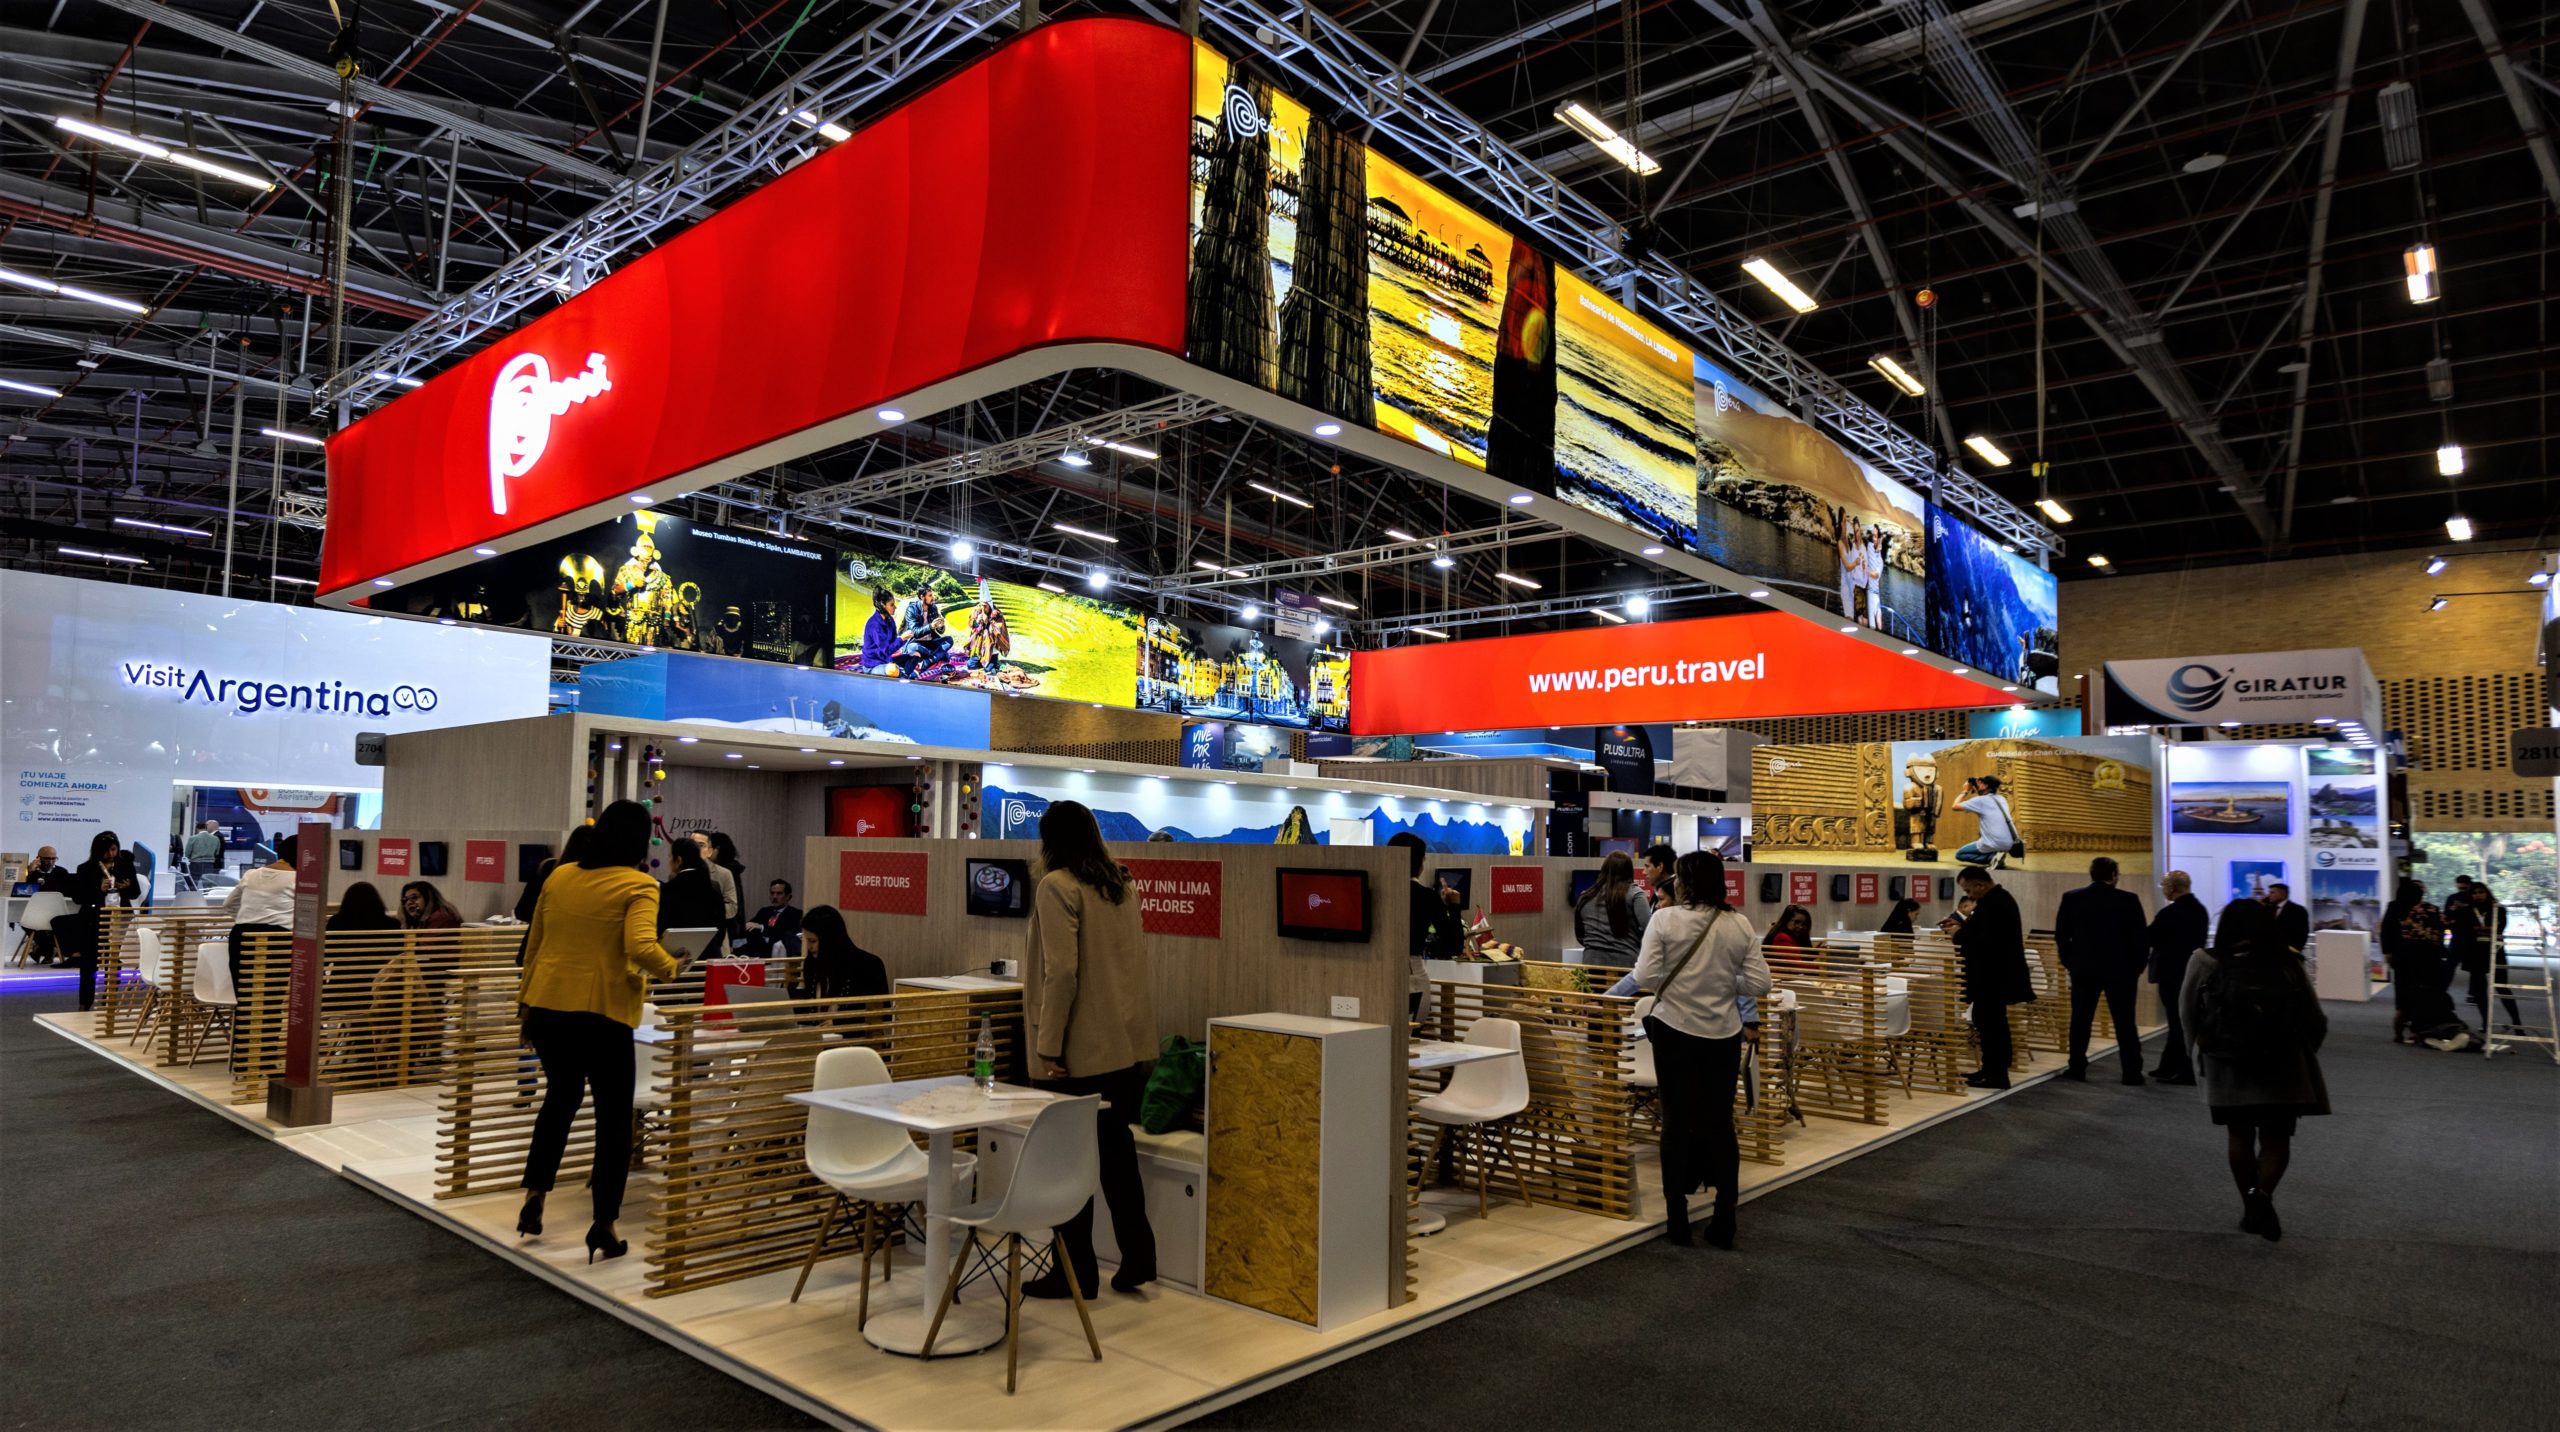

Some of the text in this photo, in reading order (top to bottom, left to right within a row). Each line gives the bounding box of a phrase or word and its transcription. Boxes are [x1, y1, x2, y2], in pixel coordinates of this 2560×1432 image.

[692, 528, 713, 539] Museo
[714, 532, 737, 543] Tumbas
[738, 537, 757, 547] Reales
[783, 547, 822, 560] LAMBAYEQUE
[1528, 653, 1765, 693] www.peru.travel
[125, 663, 391, 716] Visit Argentina
[2234, 676, 2347, 693] GIRATUR
[1193, 729, 1213, 743] VIVE
[1192, 743, 1210, 758] POR
[1603, 744, 1645, 758] PLUSULTRA
[20, 771, 66, 780] ¡TU VIAJE
[20, 780, 107, 790] COMIENZA AHORA!
[669, 817, 712, 834] prom
[855, 875, 910, 888] SUPER TOURS
[1155, 880, 1176, 894] INN
[1180, 881, 1211, 896] LIMA
[1502, 884, 1532, 893] LIMA TOURS
